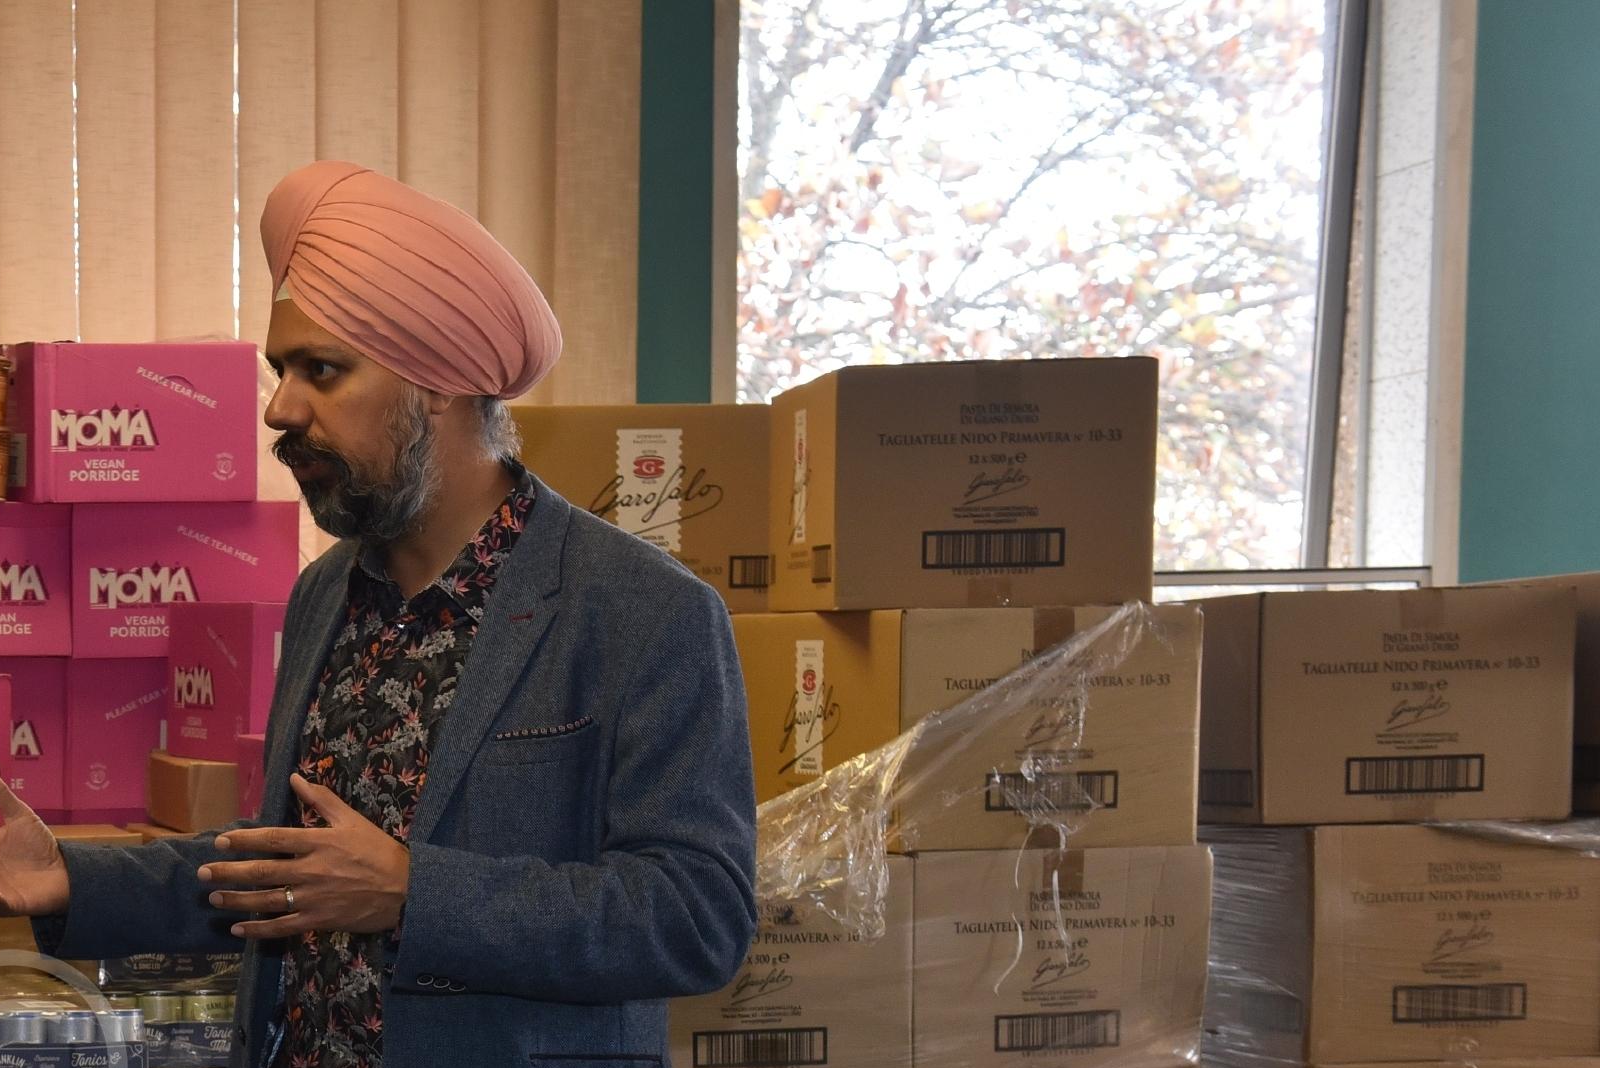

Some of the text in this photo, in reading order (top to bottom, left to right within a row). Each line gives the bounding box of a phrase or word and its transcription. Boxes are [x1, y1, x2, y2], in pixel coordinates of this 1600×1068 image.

[136, 366, 218, 409] PLEASE TEAR HERE
[50, 408, 157, 452] MOMA
[878, 428, 1122, 446] TAGLIATELLE NIDO PRIMAVERA 10-33
[84, 459, 125, 470] VEGAN
[69, 470, 140, 482] PORRIDGE
[177, 525, 259, 567] PLEASE TEAR HERE
[89, 566, 199, 609] MOMA
[125, 615, 166, 626] VEGAN
[110, 626, 170, 638] PORRIDG
[1302, 656, 1540, 675] TAGLIATELLE NIDO PRIMAVERA 10-33
[174, 666, 215, 708] MOMA
[1140, 674, 1171, 686] 10-33
[105, 703, 139, 721] PLEASE
[1066, 917, 1128, 931] PRIMAVERA
[1144, 915, 1175, 928] 10-33
[764, 932, 830, 944] PRIMAVERA
[204, 1026, 234, 1040] Tonic
[71, 1052, 107, 1067] Tonics
[110, 1051, 122, 1065] &
